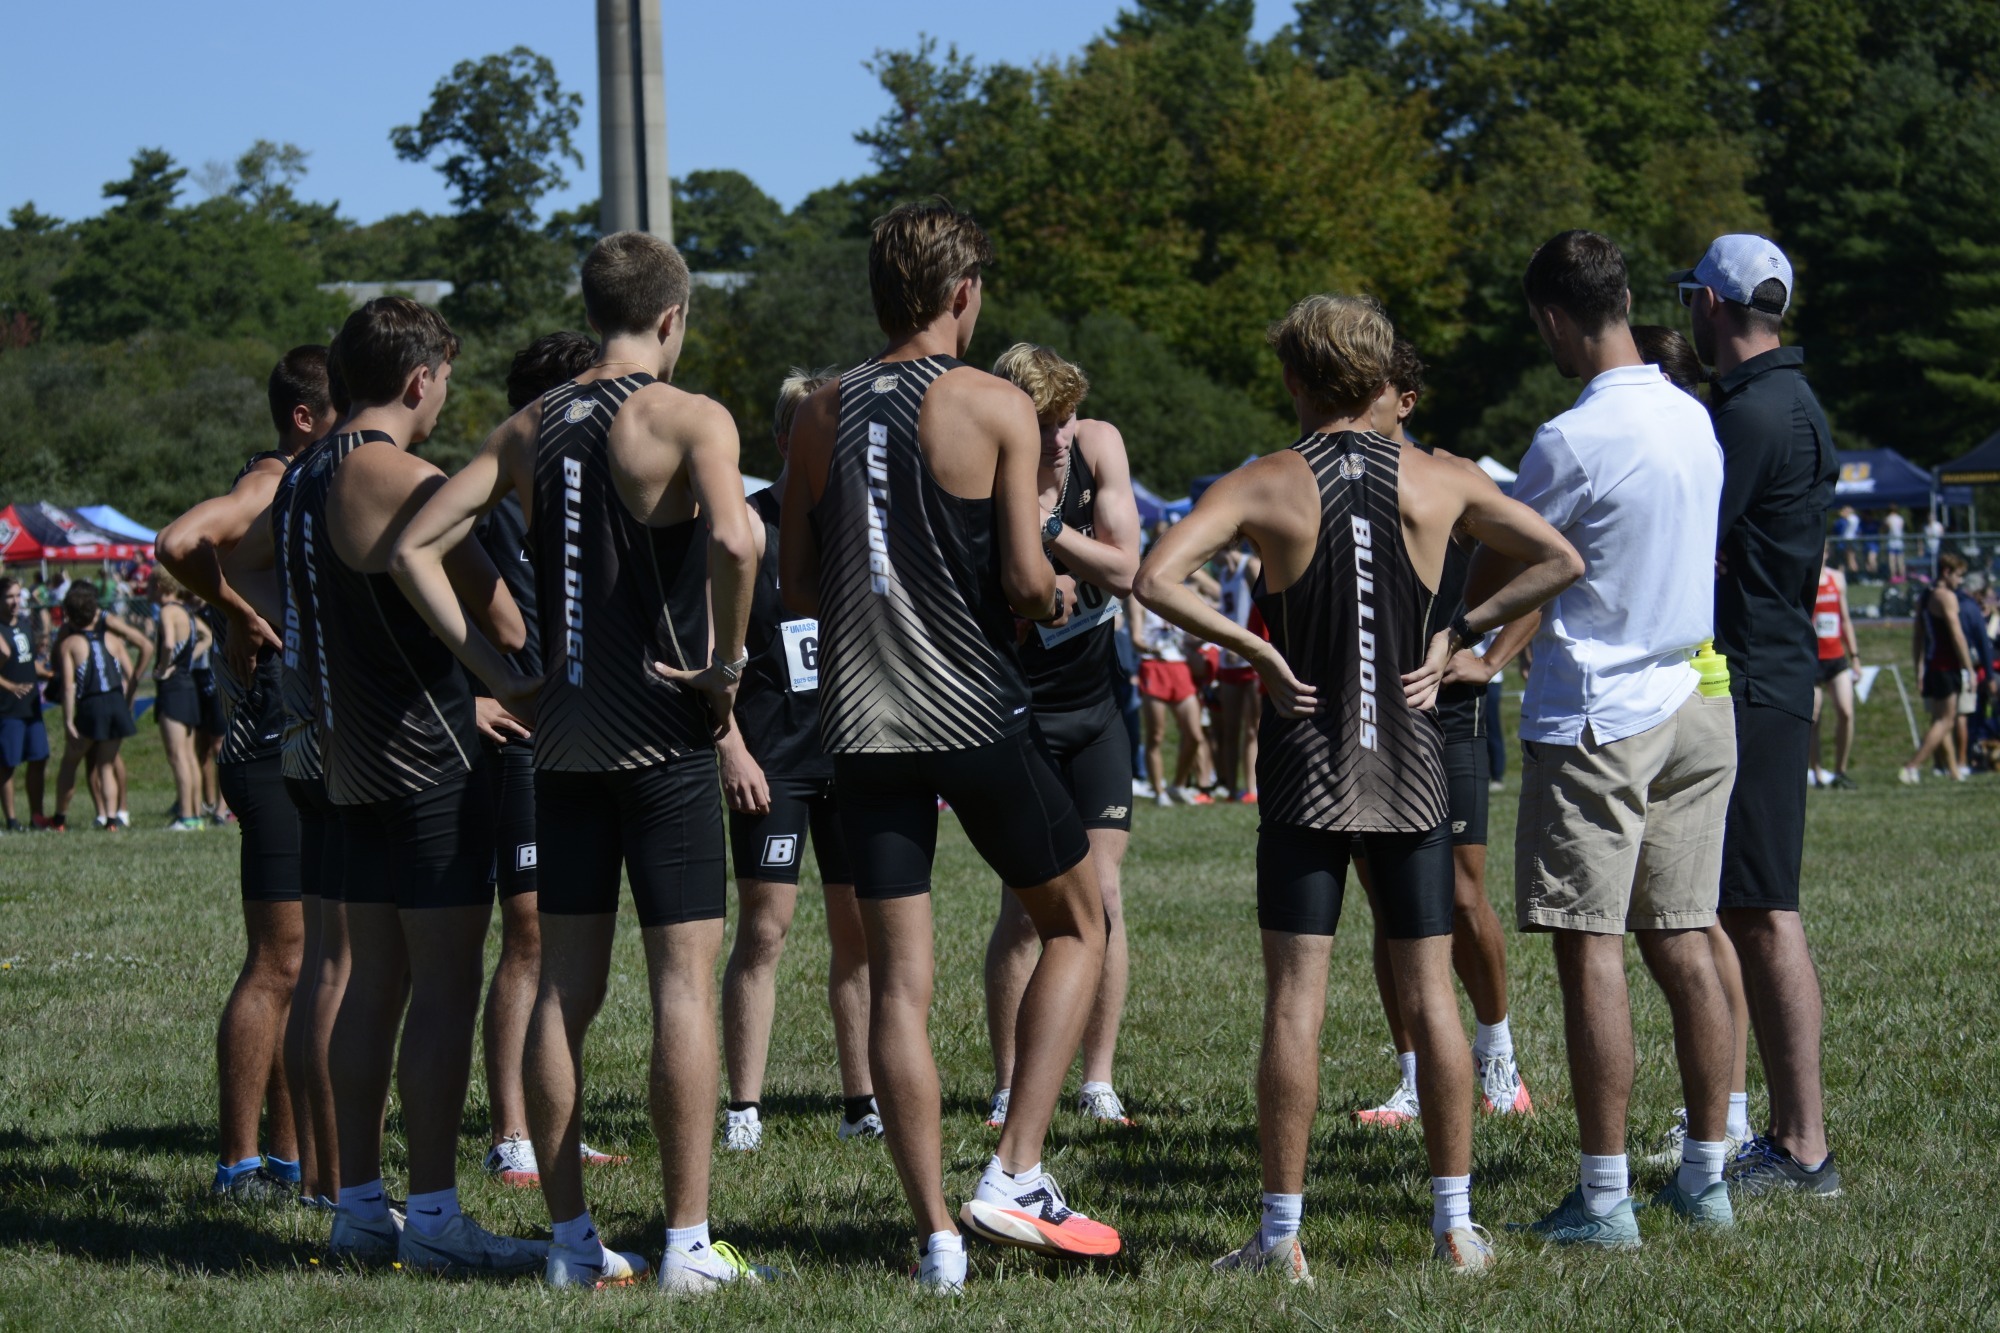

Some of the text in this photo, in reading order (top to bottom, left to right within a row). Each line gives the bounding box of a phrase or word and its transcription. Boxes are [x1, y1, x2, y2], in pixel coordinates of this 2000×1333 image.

[866, 420, 890, 598] BULLDOGS
[563, 456, 584, 689] BULLDOGS
[789, 622, 816, 634] UMASS
[1350, 514, 1378, 753] BULLDOGS
[799, 636, 818, 671] 6
[793, 677, 807, 685] 2025
[764, 836, 796, 864] B
